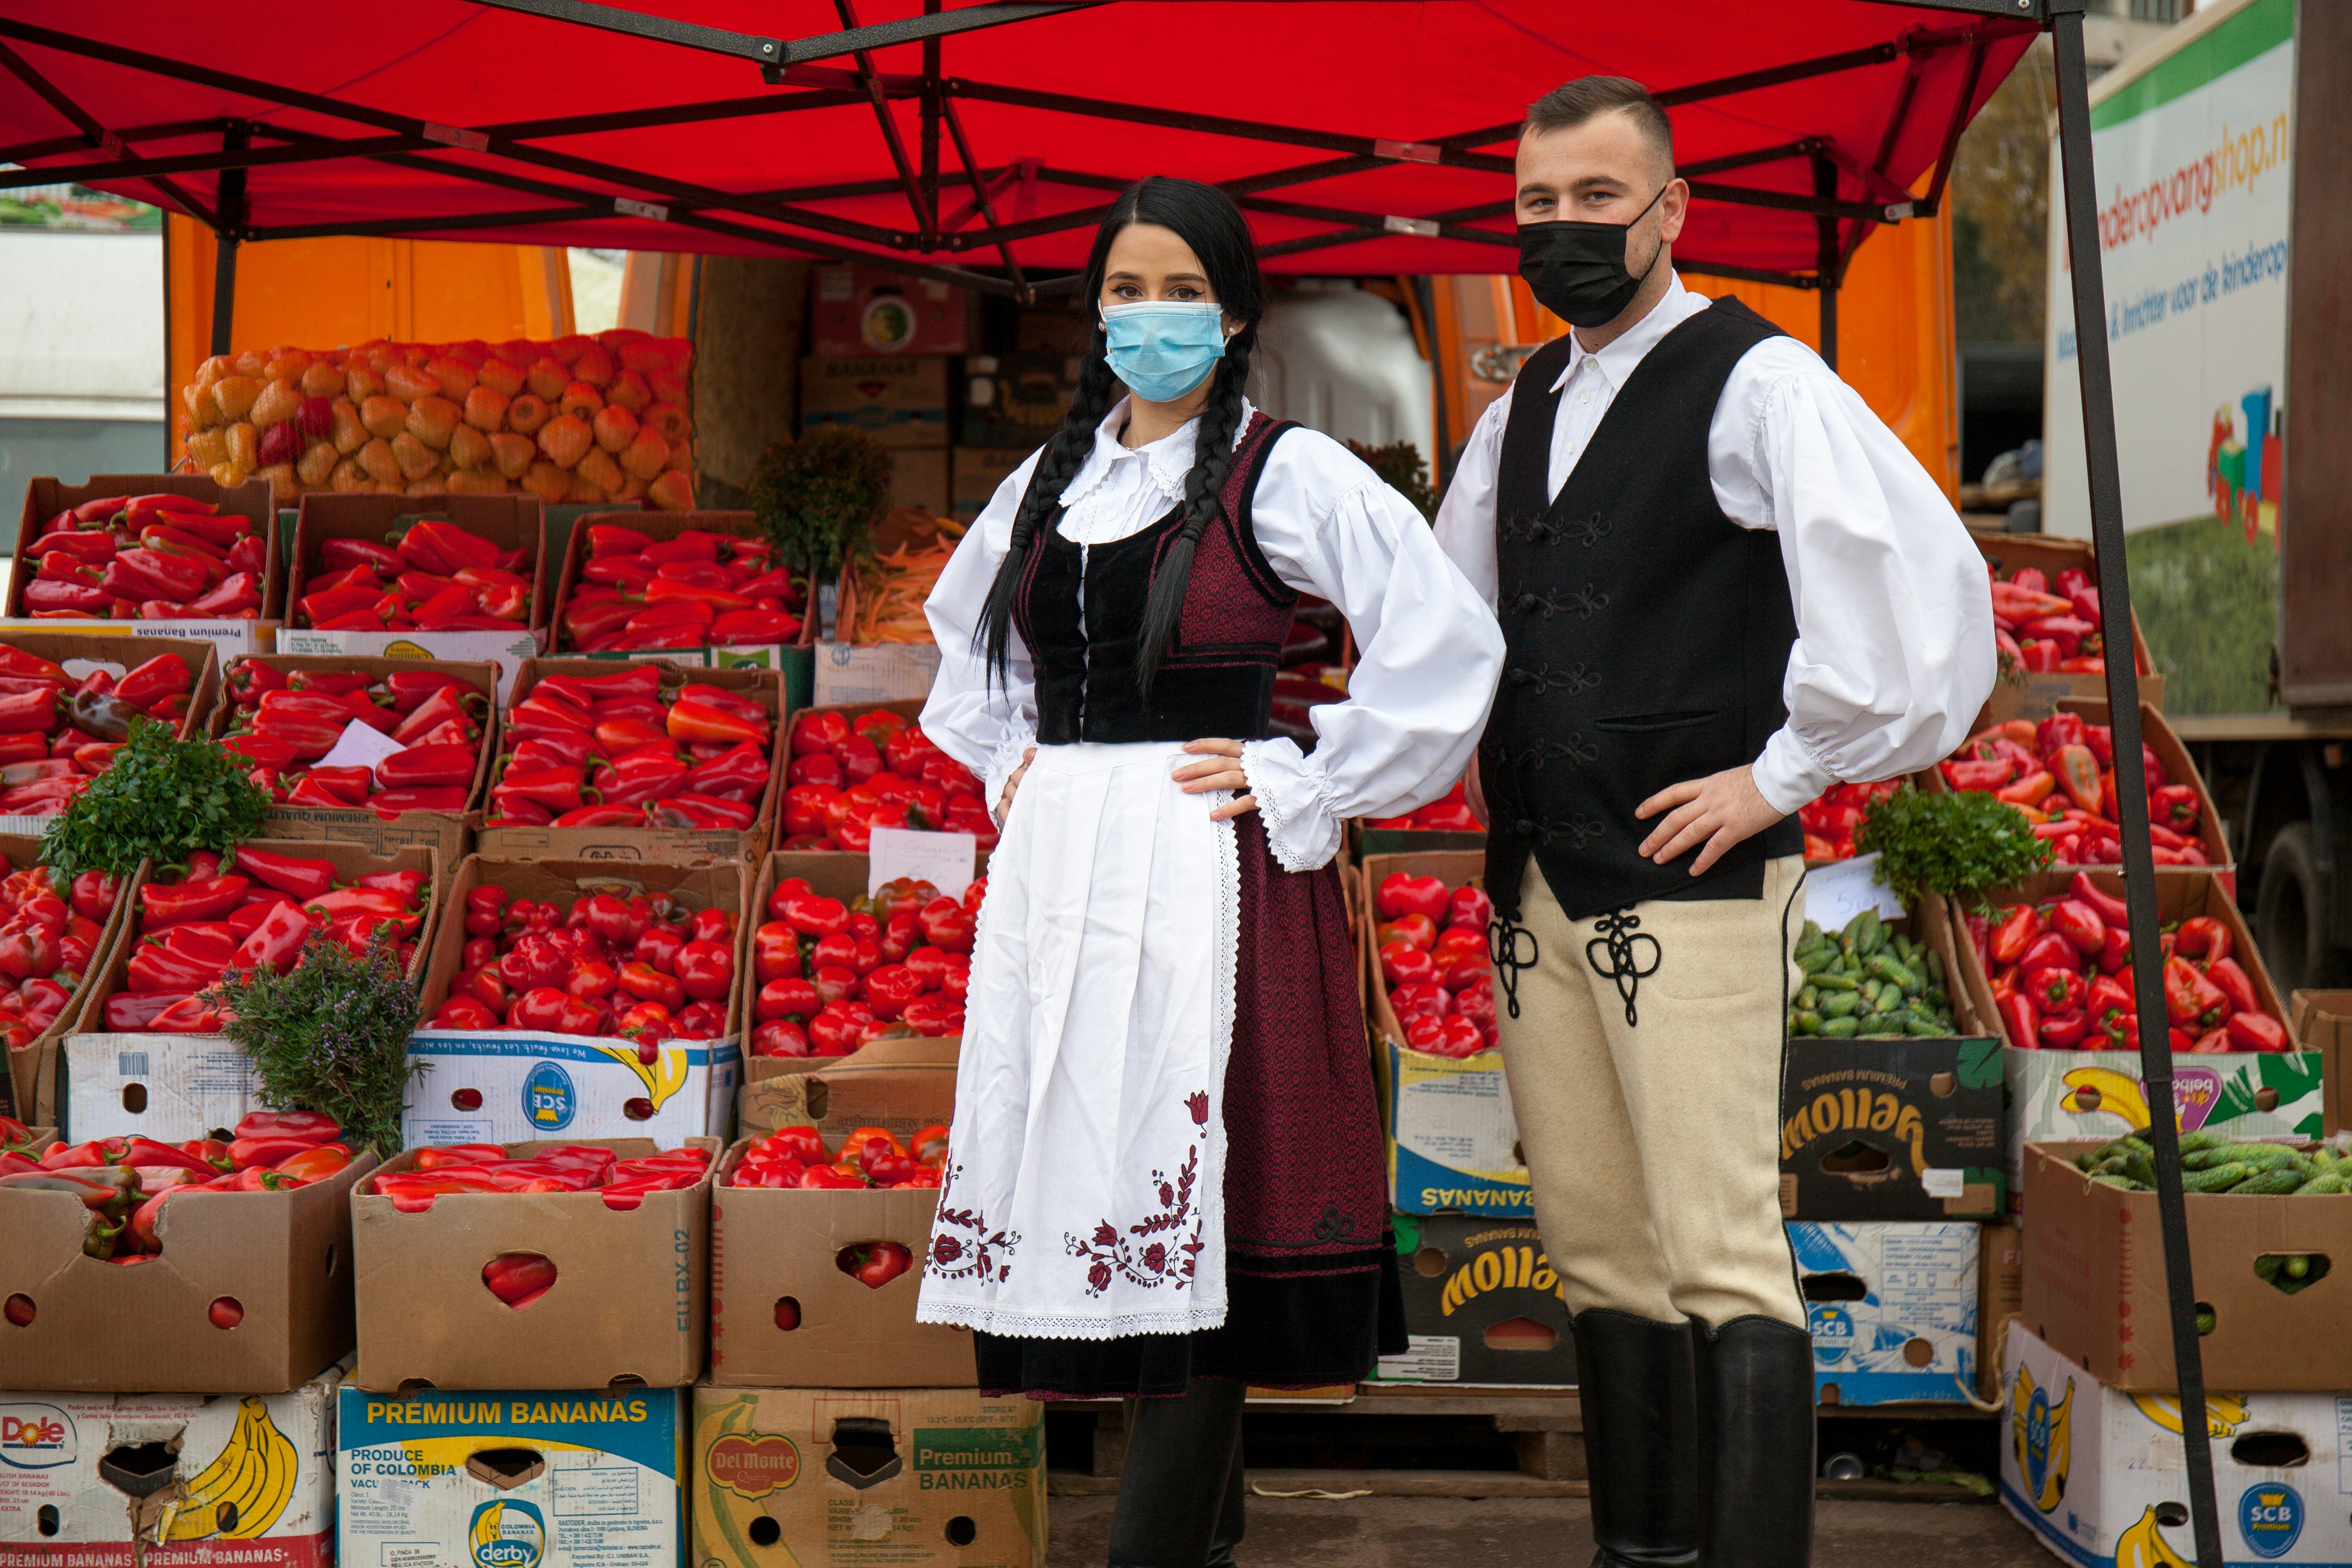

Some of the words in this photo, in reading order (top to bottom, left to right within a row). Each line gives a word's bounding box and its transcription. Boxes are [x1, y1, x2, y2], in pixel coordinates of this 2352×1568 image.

[2201, 258, 2219, 304] de
[136, 627, 186, 638] Bananas
[188, 627, 242, 638] Premium
[268, 811, 311, 821] QUALIT
[313, 811, 370, 823] PREMIUM
[438, 1042, 452, 1052] les
[469, 1041, 501, 1054] fruits,
[504, 1043, 519, 1054] Les
[550, 1046, 569, 1057] love
[573, 1048, 586, 1059] We
[1800, 1069, 1855, 1092] BANANAS
[1856, 1070, 1908, 1090] PREMIUM
[533, 1094, 568, 1111] SCB
[1782, 1087, 1929, 1178] yellow
[1420, 1188, 1534, 1207] BANANAS
[1464, 1229, 1518, 1248] BANANAS
[674, 1228, 690, 1292] BX-02
[677, 1300, 690, 1332] EU
[1812, 1320, 1847, 1336] SCB
[367, 1401, 502, 1425] PREMIUM
[510, 1400, 647, 1424] BANANAS
[2, 1416, 65, 1445] Dole
[351, 1449, 423, 1462] PRODUCE
[715, 1452, 741, 1469] Del
[743, 1452, 794, 1469] Monte
[351, 1463, 372, 1475] OF
[376, 1463, 457, 1476] COLOMBIA
[737, 1470, 771, 1485] Quality
[919, 1471, 1028, 1490] BANANAS
[2250, 1506, 2292, 1522] SCB
[2252, 1522, 2291, 1532] Premium
[0, 1553, 63, 1567] PREMIUM
[67, 1553, 132, 1567] BANANAS
[143, 1550, 212, 1568] PREMIUM
[215, 1548, 283, 1564] BANANAS
[480, 1542, 533, 1567] derby
